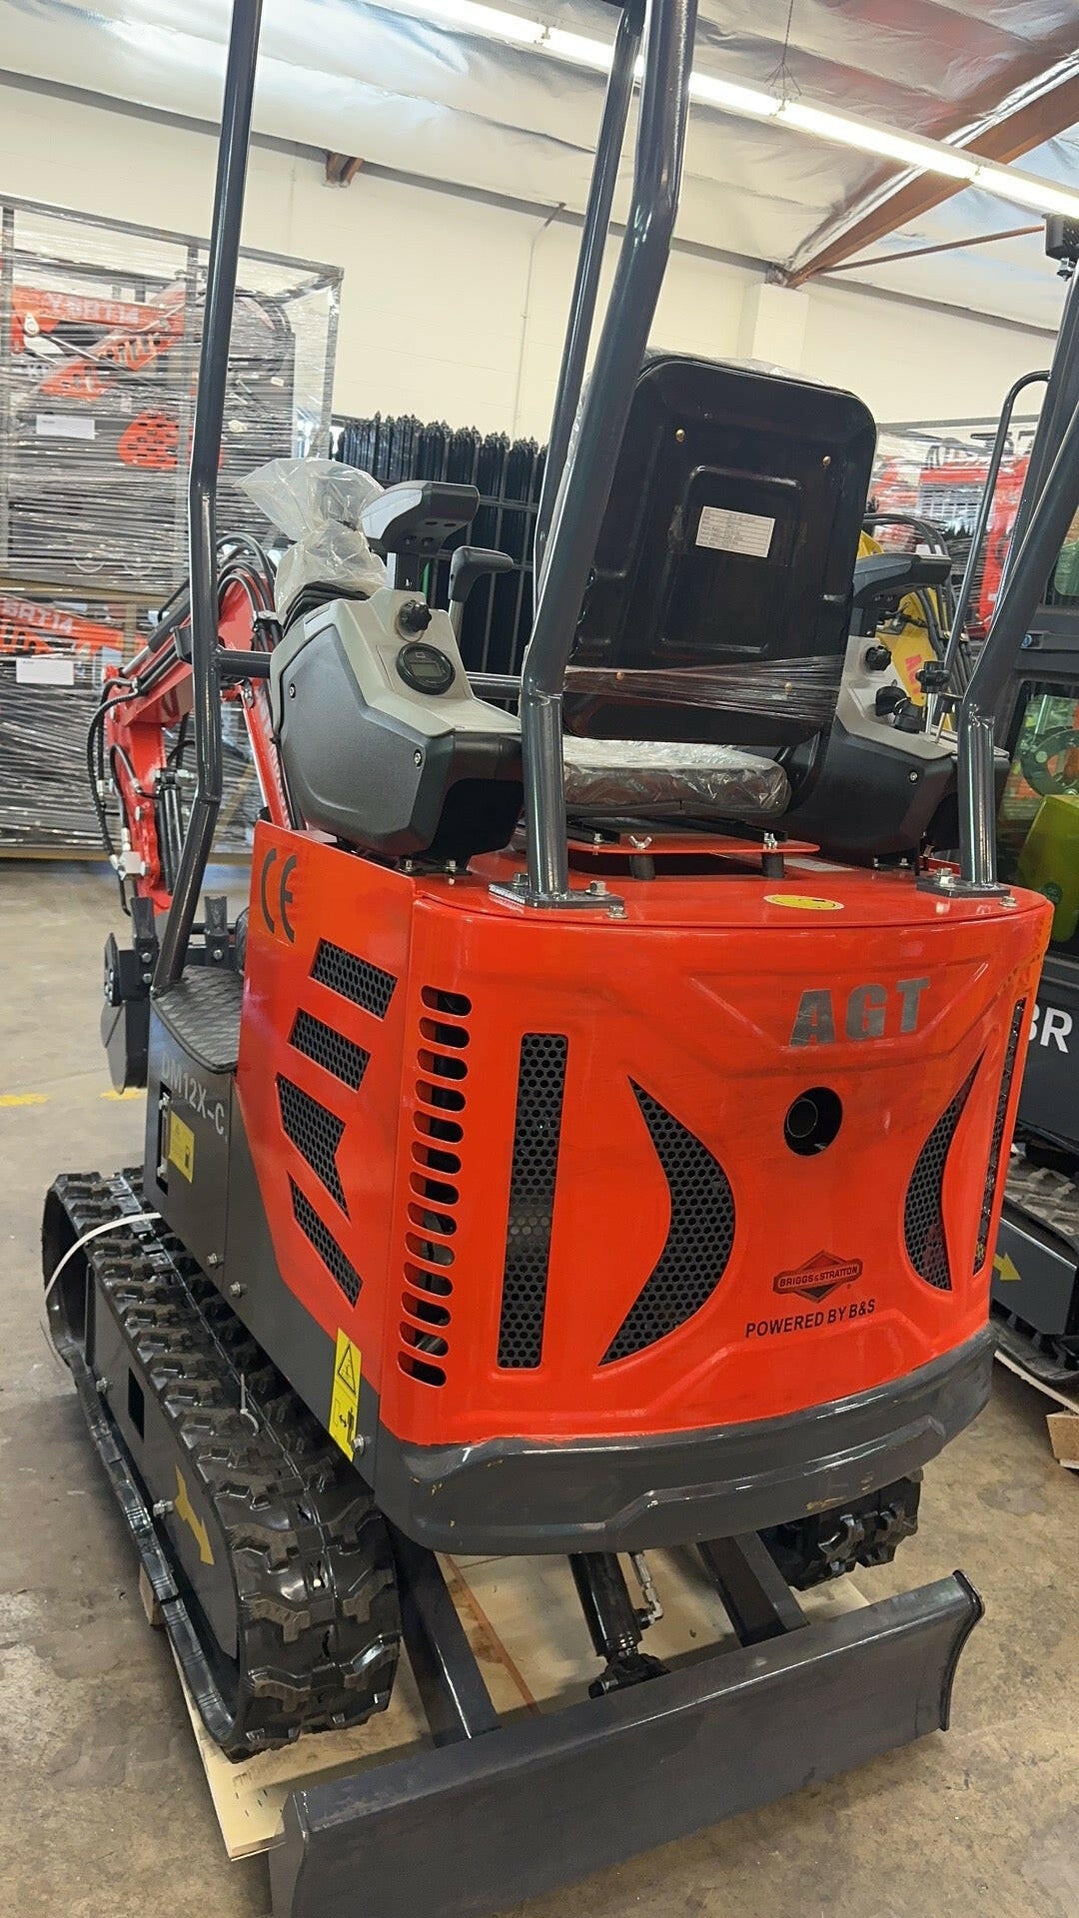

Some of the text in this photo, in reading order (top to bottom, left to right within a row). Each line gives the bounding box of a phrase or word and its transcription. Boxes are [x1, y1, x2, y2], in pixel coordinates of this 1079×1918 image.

[789, 976, 930, 1048] AGT
[745, 1298, 876, 1339] POWERED BY B&S
